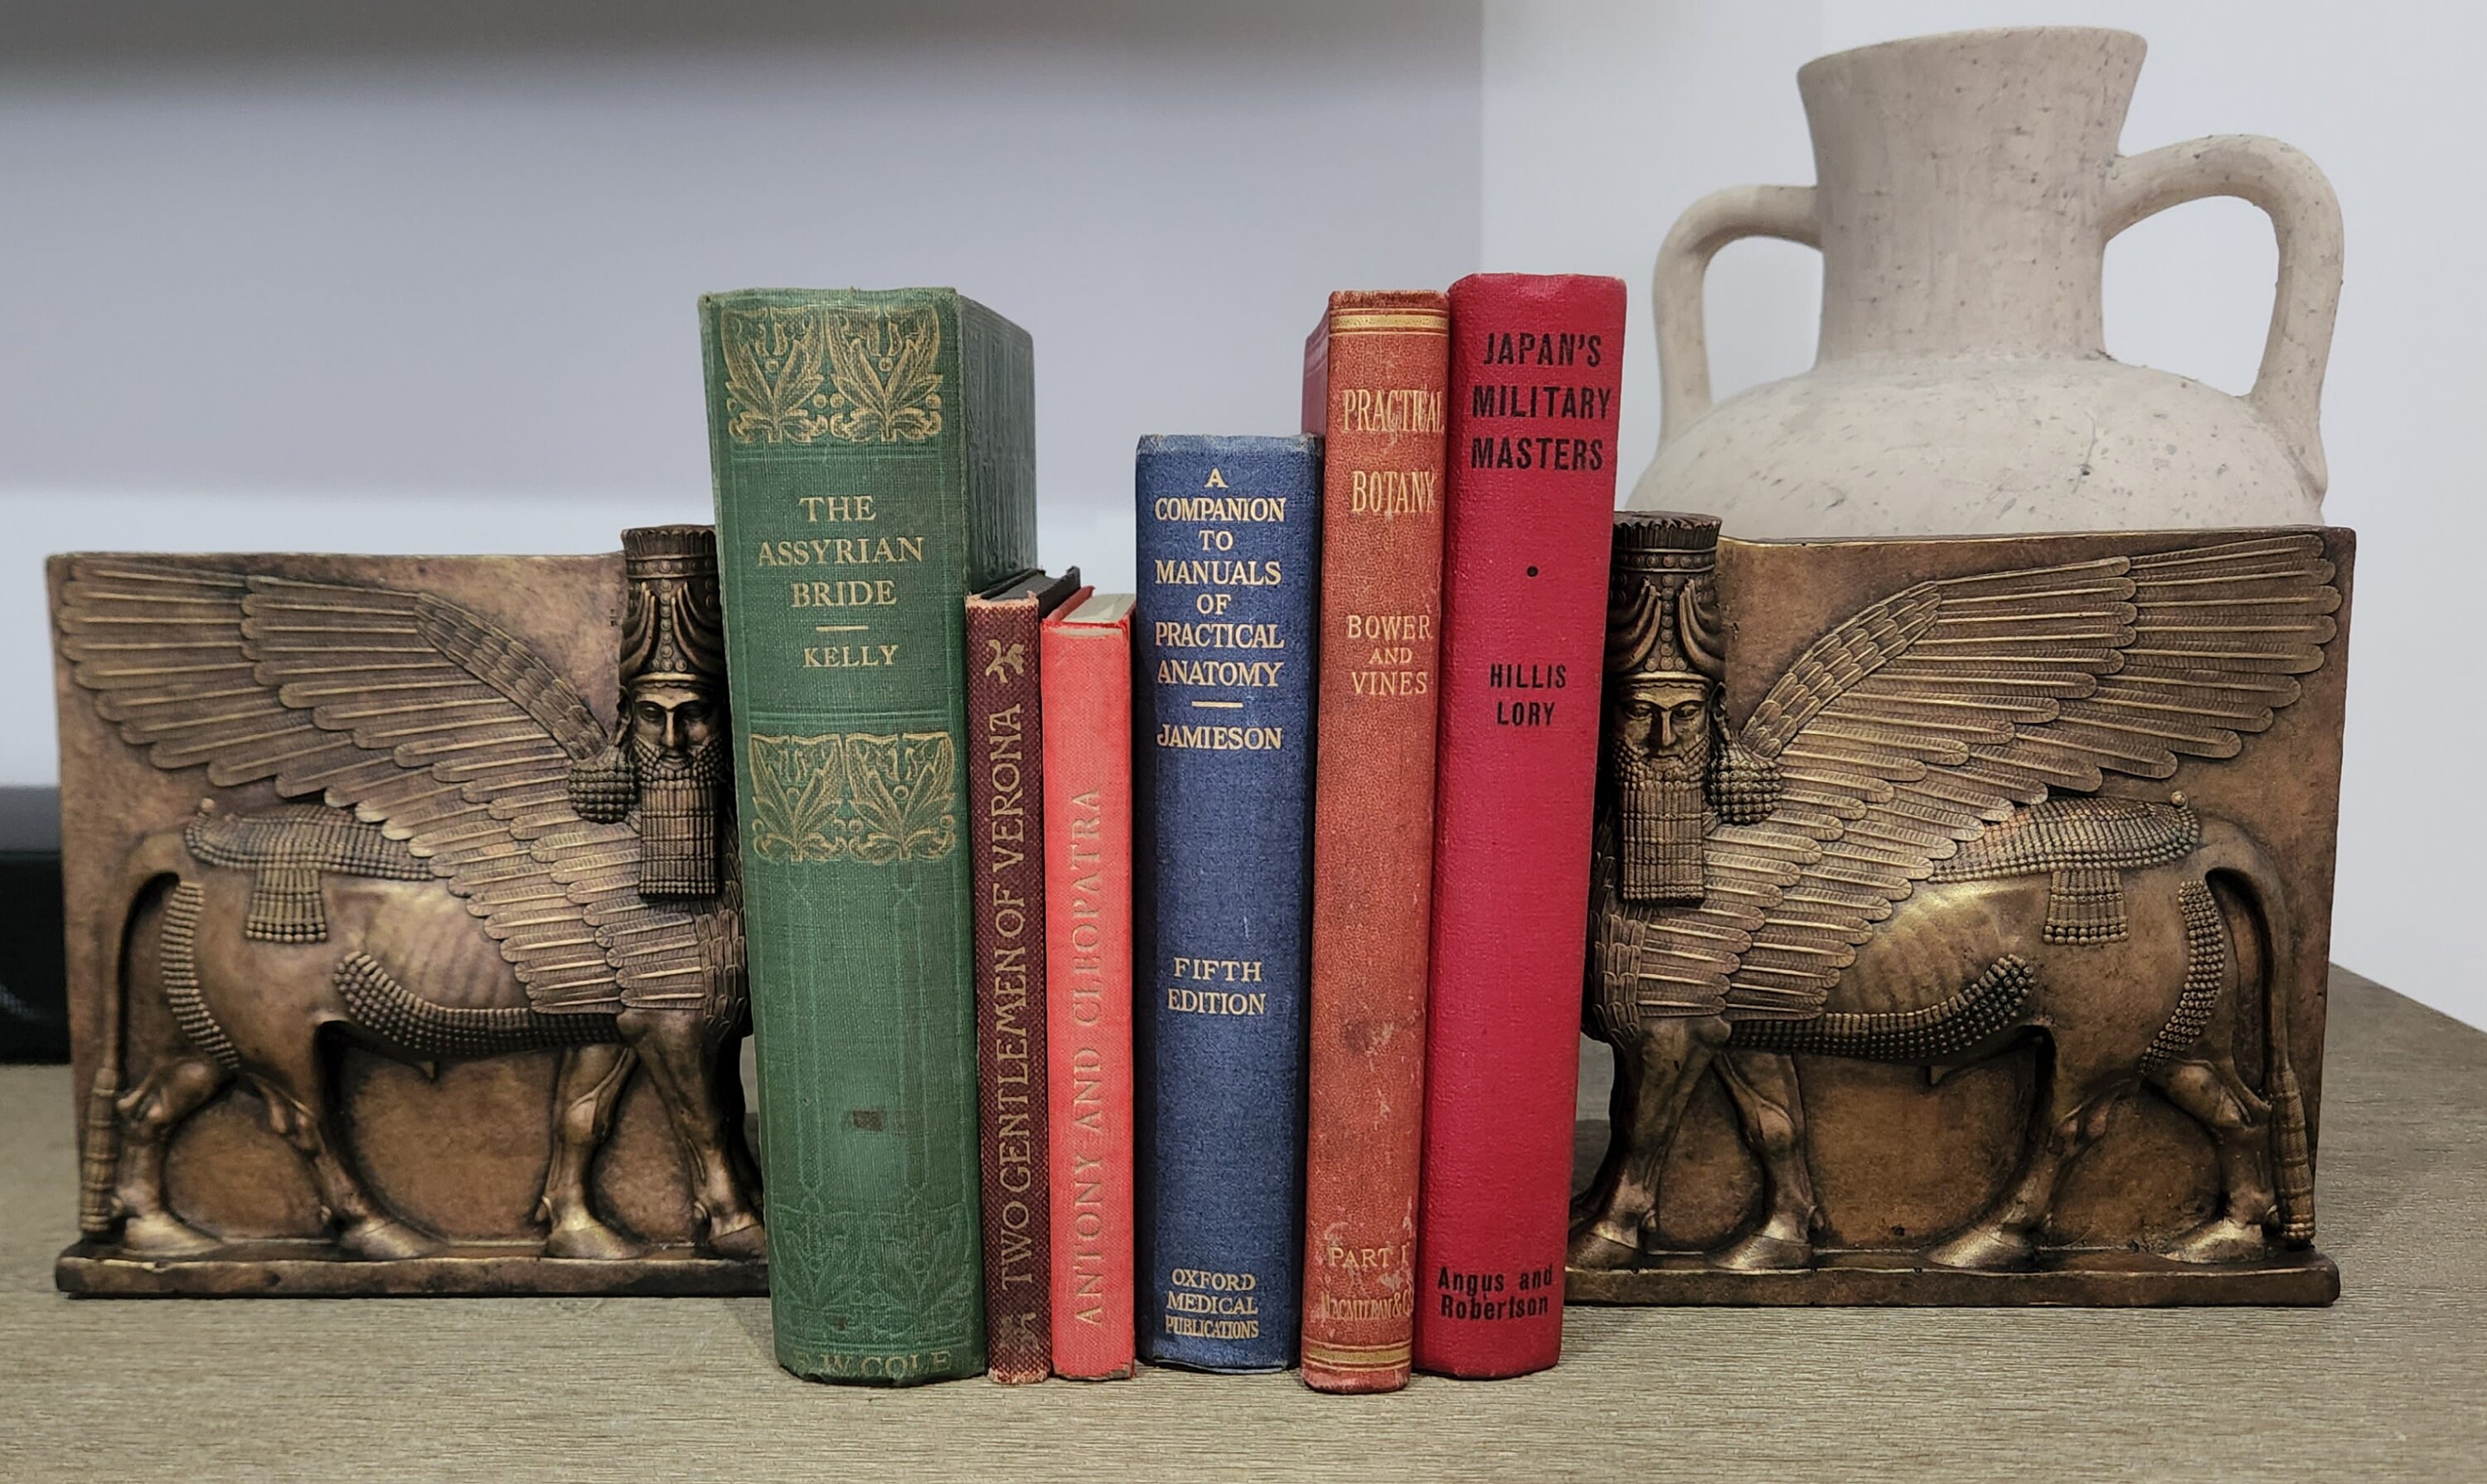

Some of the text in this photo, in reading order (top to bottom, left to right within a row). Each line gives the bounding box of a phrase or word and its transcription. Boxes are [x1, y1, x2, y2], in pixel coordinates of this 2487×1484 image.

[1483, 332, 1602, 368] JAPAN'S
[1342, 388, 1445, 434] PRACTICAL
[1471, 384, 1612, 419] MILITARY
[1471, 437, 1604, 472] MASTERS
[1204, 468, 1229, 488] A
[1351, 469, 1436, 514] BOTANY
[798, 495, 877, 522] THE
[1155, 497, 1287, 522] COMPANION
[758, 536, 924, 567] ASSYRIAN
[1199, 529, 1234, 551] TO
[1155, 559, 1282, 586] MANUALS
[791, 580, 898, 608] BRIDE
[1196, 594, 1232, 615] OF
[1155, 622, 1285, 649] PRACTICAL
[1347, 614, 1433, 641] BOWER
[803, 644, 899, 668] KELLY
[1368, 647, 1413, 665] AND
[1157, 660, 1285, 687] ANATOMY
[1350, 671, 1429, 696] VINES
[1490, 663, 1567, 689] HILLIS
[1496, 701, 1555, 727] LORY
[1156, 723, 1284, 750] JAMIESON
[1173, 957, 1263, 982] FIFTH
[988, 703, 1033, 1291] TWO GENTLEMEN OF VERONA
[1167, 987, 1267, 1016] EDITION
[1069, 789, 1104, 1326] ANTONY AND CLEOPATRA
[1328, 1246, 1394, 1268] PART
[1171, 1268, 1257, 1292] OXFORD
[1437, 1263, 1554, 1297] Angus and
[1165, 1290, 1259, 1315] MEDICAL
[1440, 1293, 1549, 1321] Robertson
[1165, 1314, 1260, 1340] PUBLICATIONS
